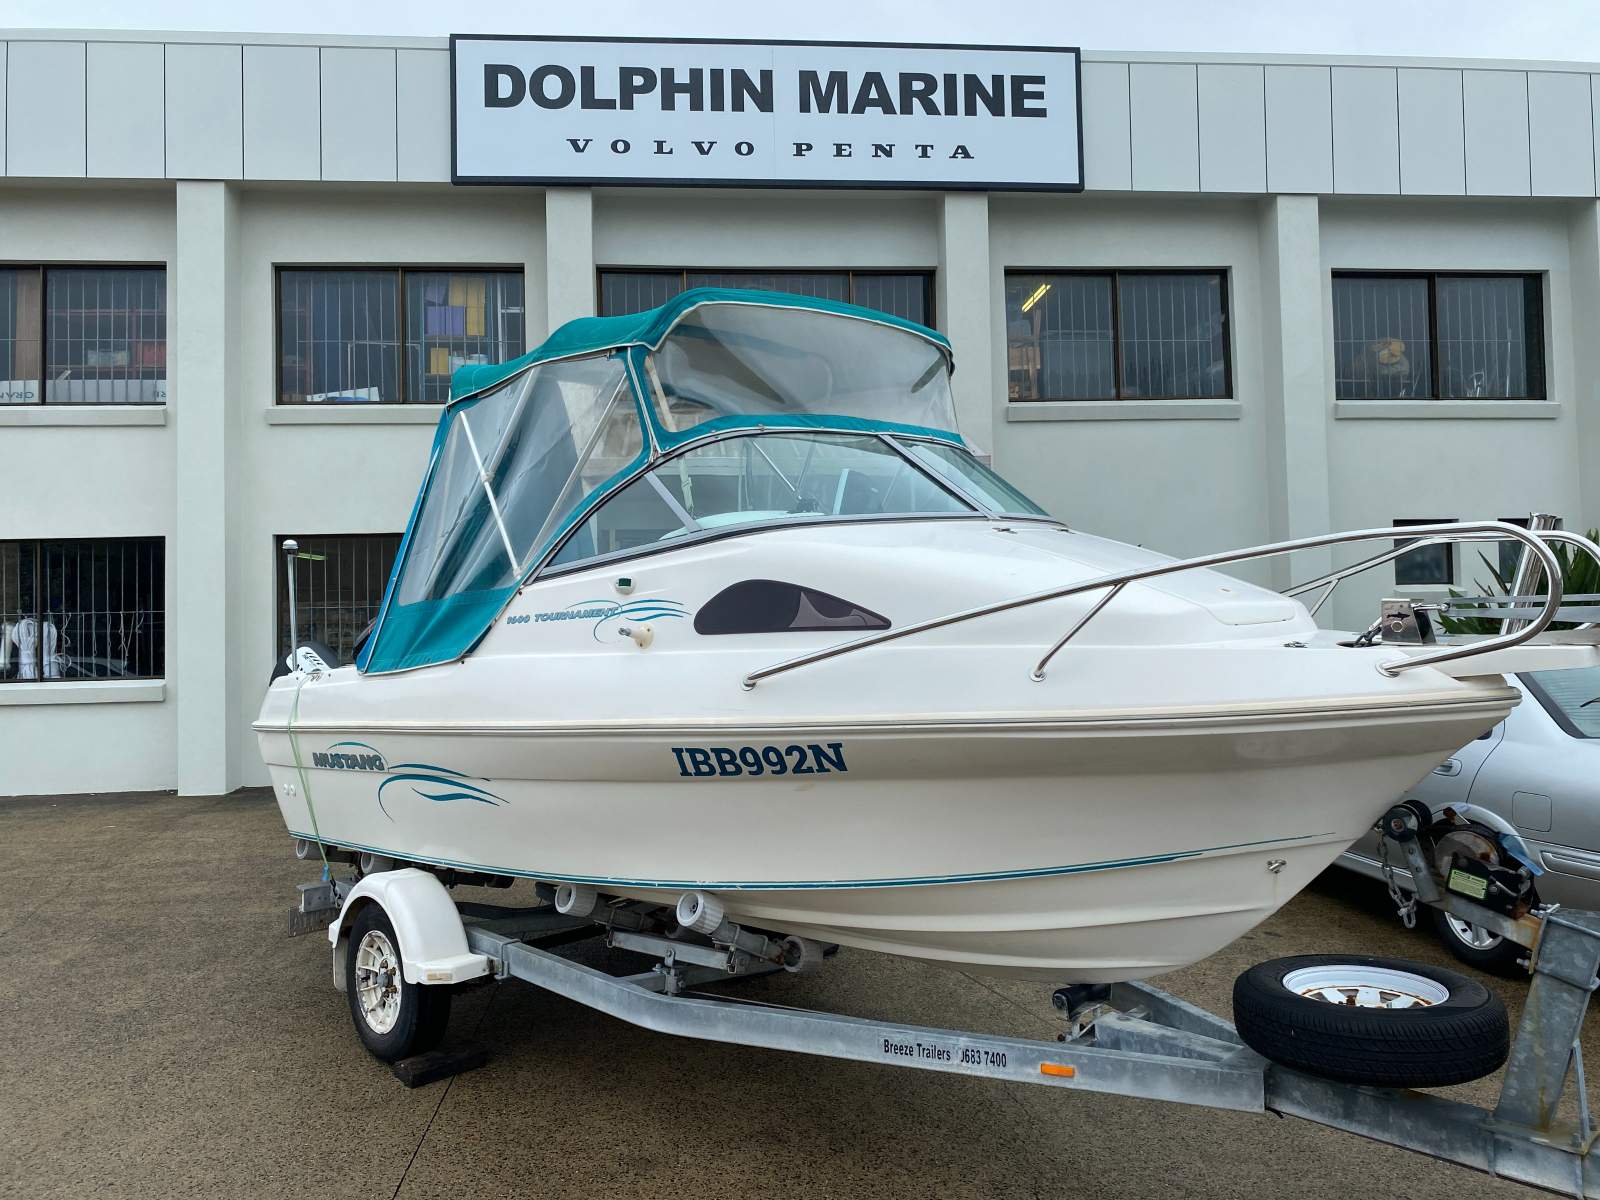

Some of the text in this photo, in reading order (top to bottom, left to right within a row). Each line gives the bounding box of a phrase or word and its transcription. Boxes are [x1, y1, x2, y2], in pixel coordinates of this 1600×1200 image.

[483, 63, 1048, 118] DOLPHIN MARINE
[566, 138, 975, 160] VOLVO PENTA
[534, 606, 619, 622] TOURNAMENT
[312, 752, 385, 771] MUSTANG
[671, 742, 848, 777] IBB992N
[883, 1038, 914, 1057] Breeze
[916, 1042, 951, 1061] Trailers
[984, 1050, 1007, 1068] 7400
